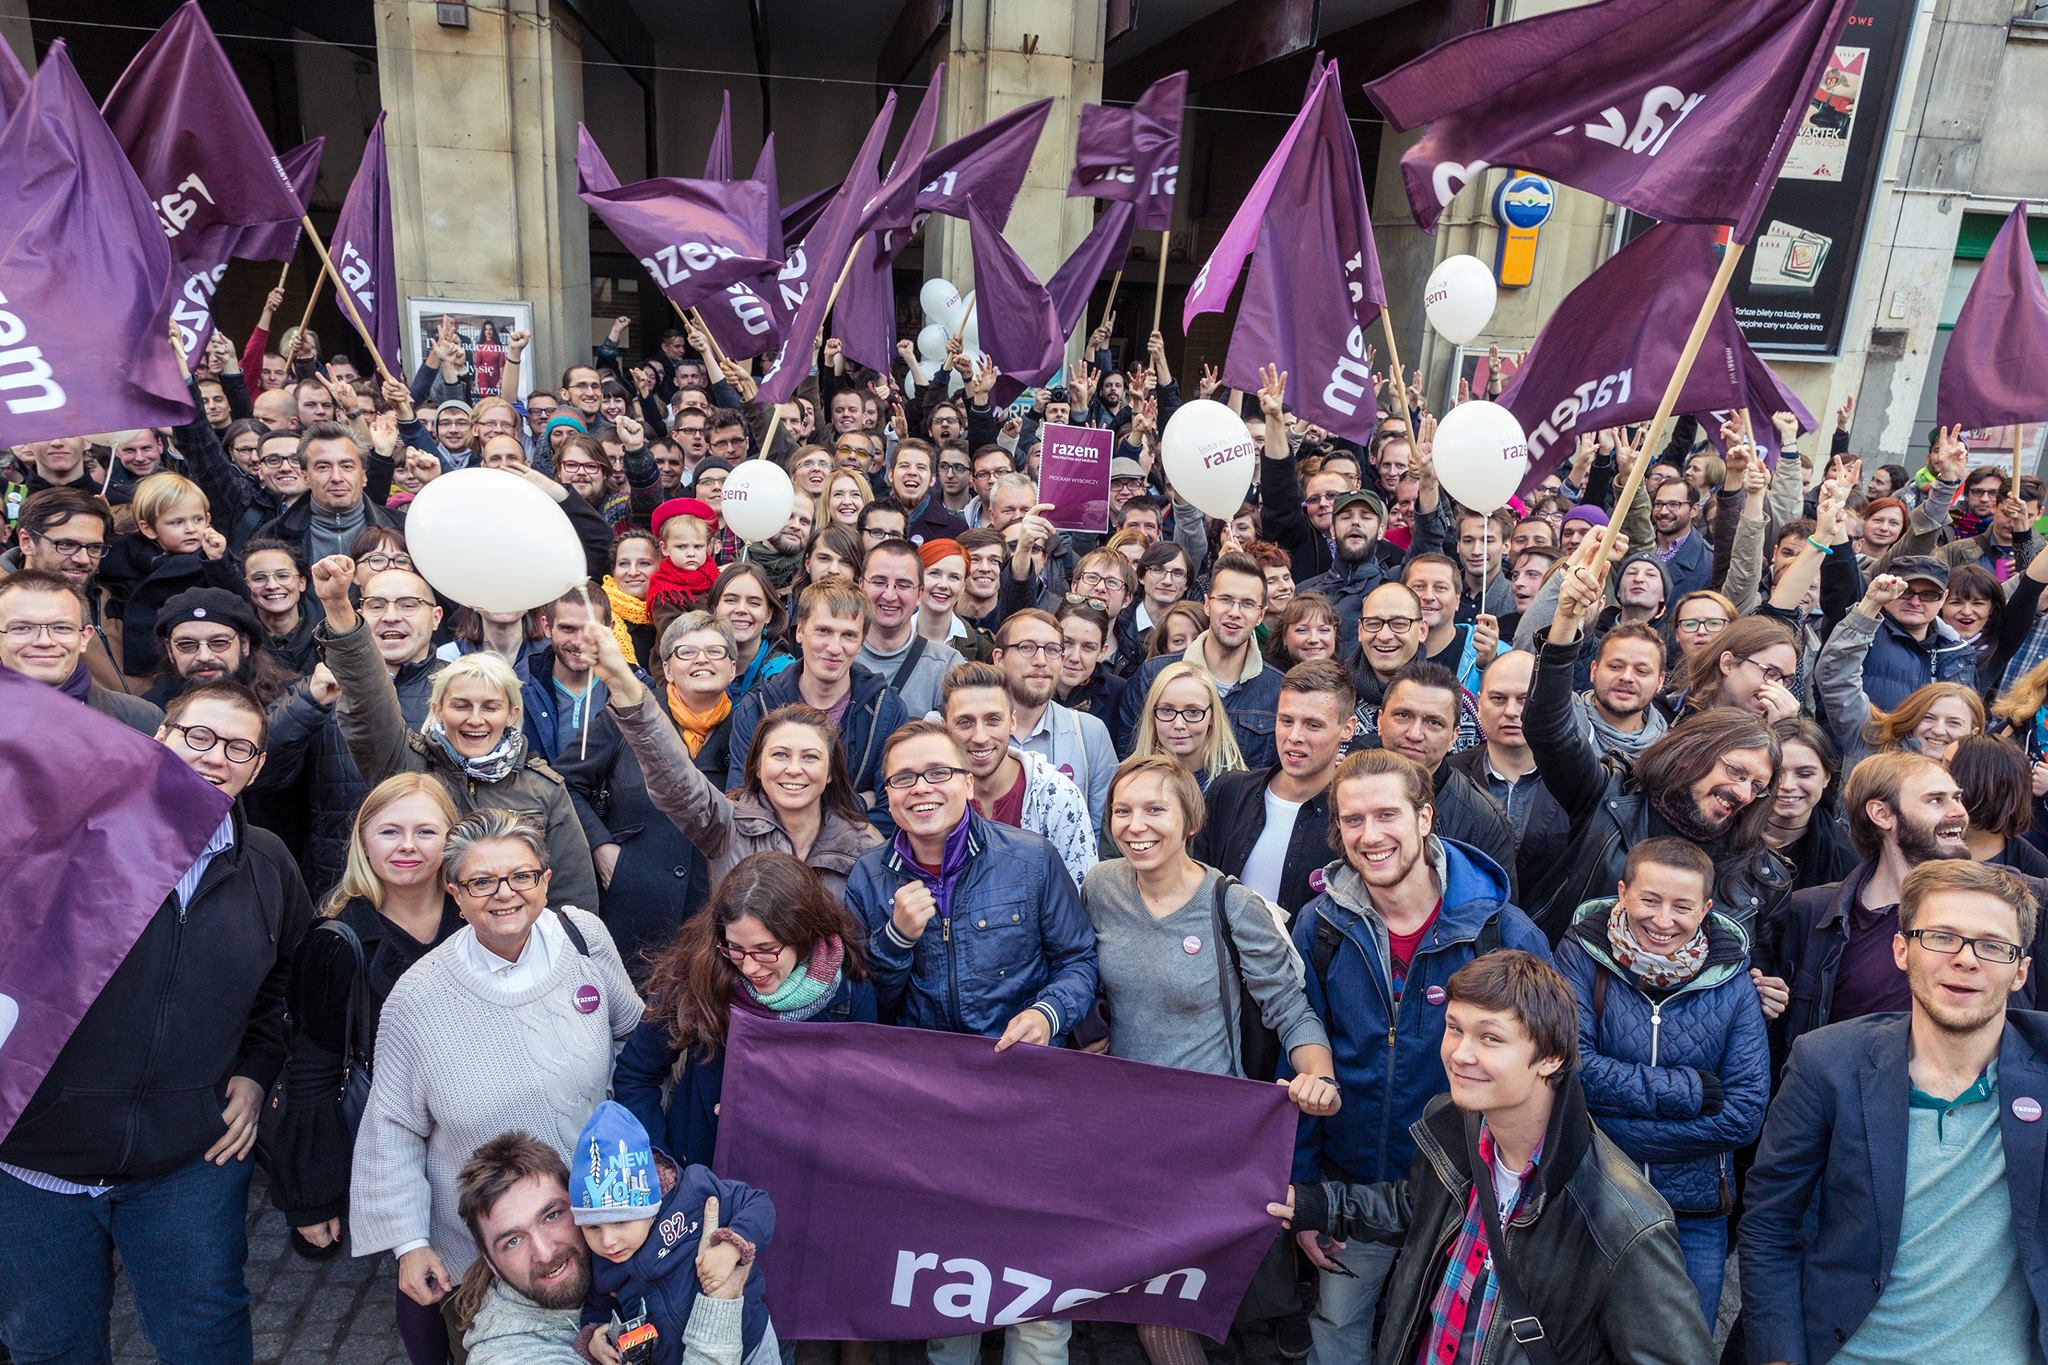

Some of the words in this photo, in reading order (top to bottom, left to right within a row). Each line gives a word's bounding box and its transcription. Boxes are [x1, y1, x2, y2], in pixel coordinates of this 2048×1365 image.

[1735, 307, 1757, 316] Tańsze
[1757, 308, 1775, 319] bilety
[1784, 310, 1802, 320] każdy
[1809, 323, 1824, 332] kina
[478, 363, 495, 377] się
[1052, 443, 1098, 459] razem
[1203, 442, 1254, 469] razem
[2014, 1106, 2041, 1114] razem
[609, 1151, 649, 1170] NEW
[584, 1171, 651, 1208] YORK
[659, 1212, 688, 1246] 82
